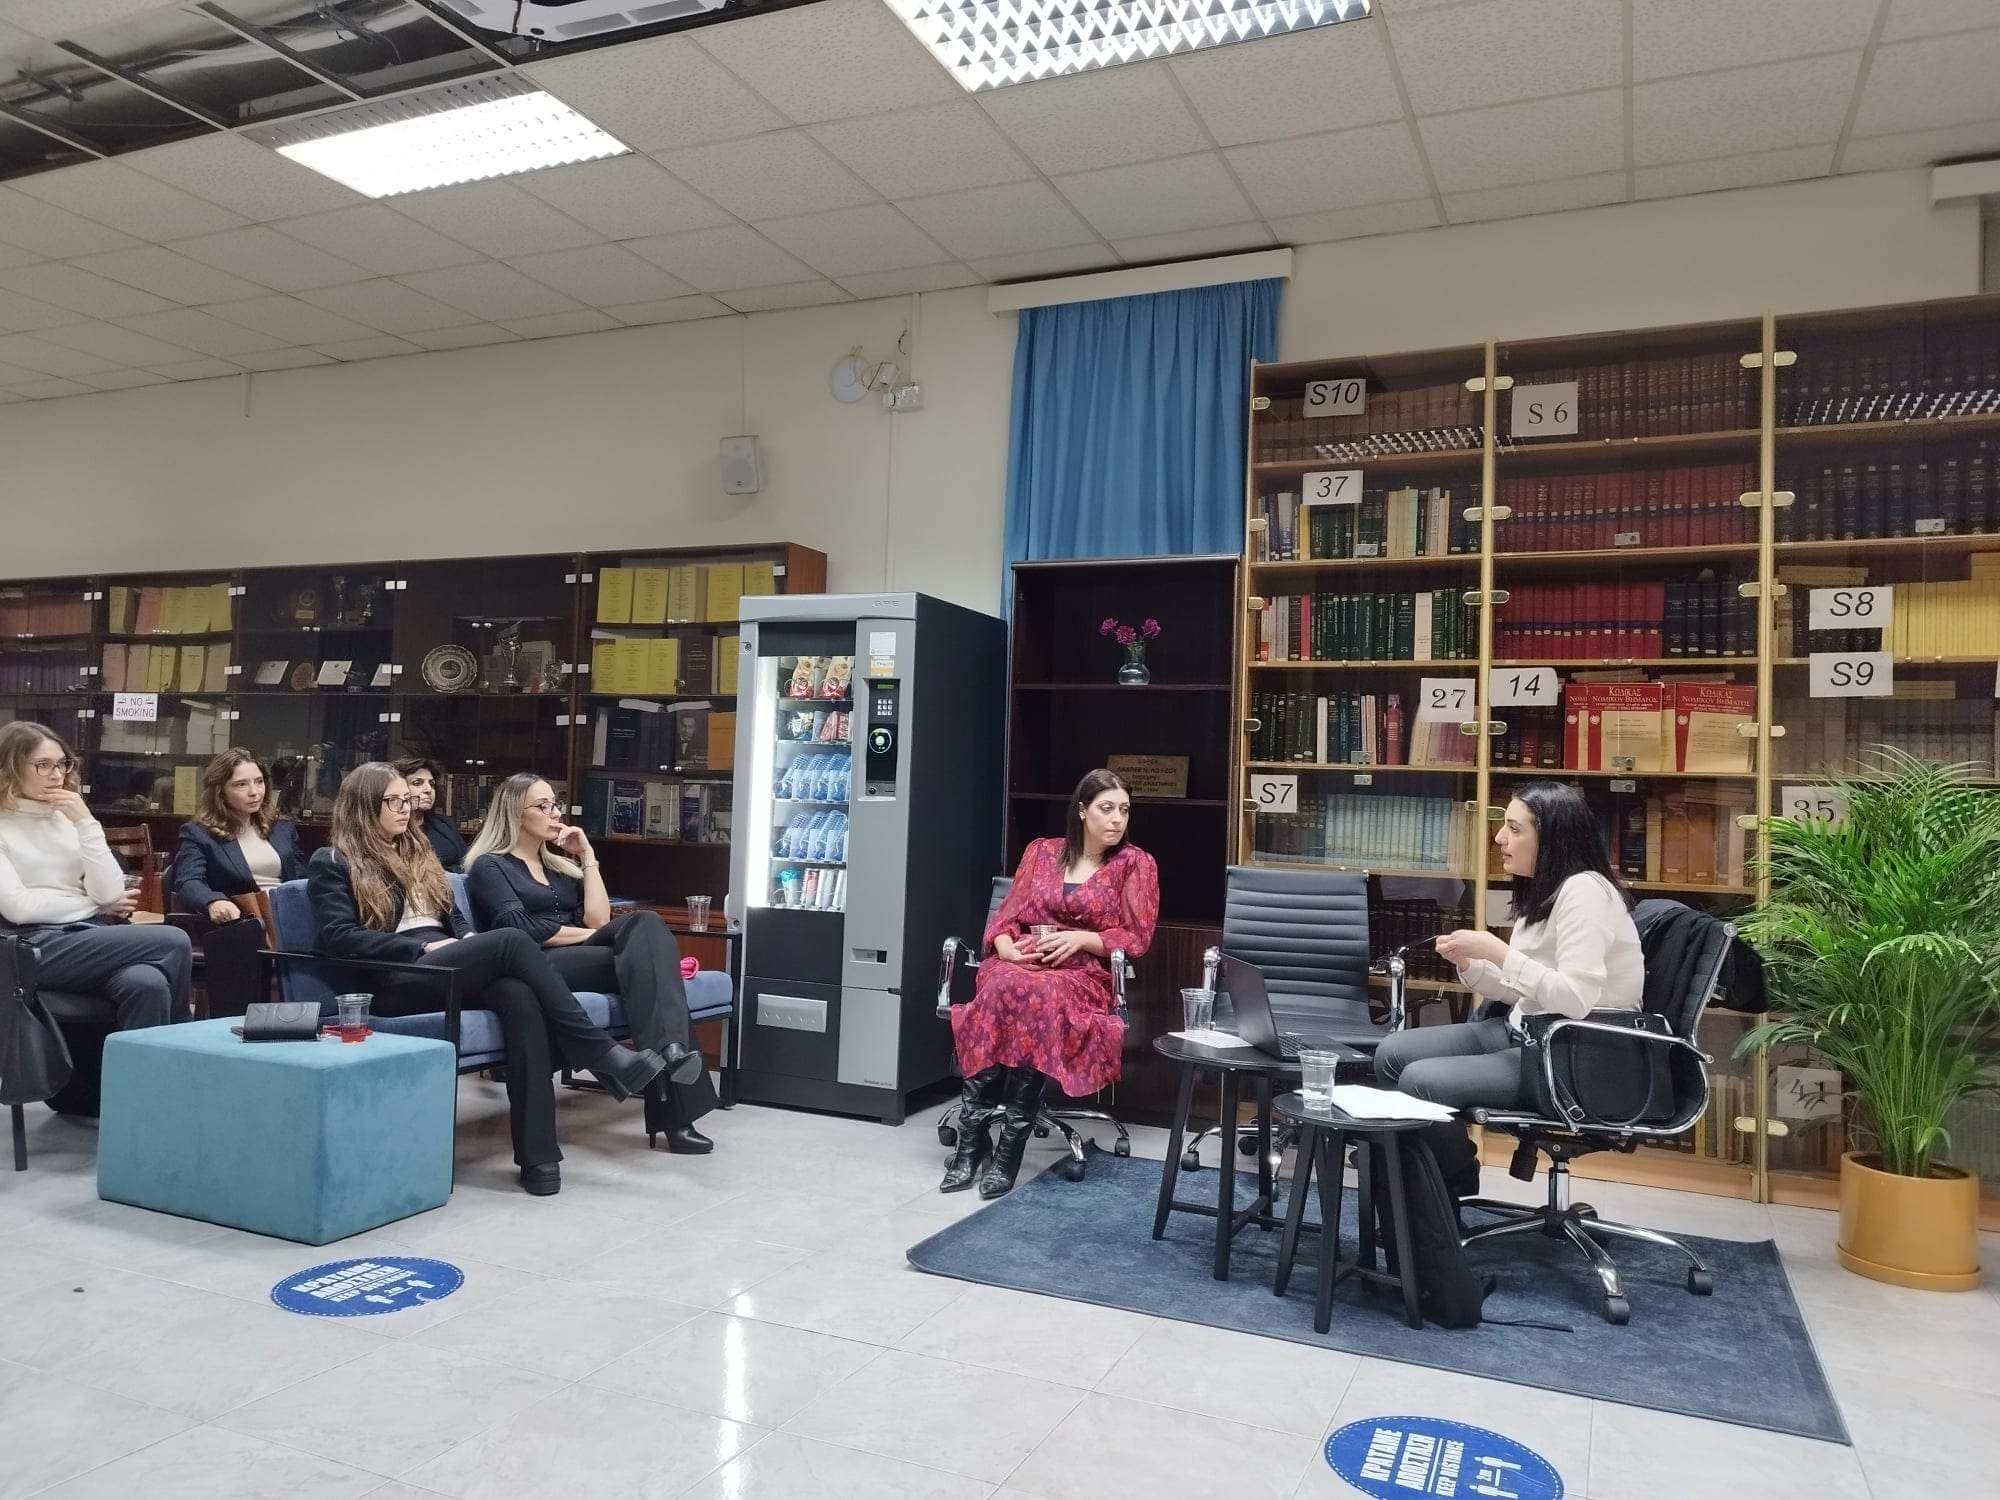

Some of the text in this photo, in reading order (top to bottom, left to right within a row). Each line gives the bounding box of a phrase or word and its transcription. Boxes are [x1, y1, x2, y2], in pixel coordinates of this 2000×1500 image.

[1309, 381, 1361, 406] S10
[1528, 401, 1568, 425] S 6
[1316, 476, 1349, 498] 37
[1830, 592, 1874, 617] S8
[1509, 674, 1541, 697] 14
[1830, 661, 1874, 687] S9
[130, 697, 143, 706] NO
[1431, 688, 1466, 709] 27
[115, 707, 155, 718] SMOKING
[1259, 782, 1294, 804] S7
[1793, 799, 1836, 824] 35
